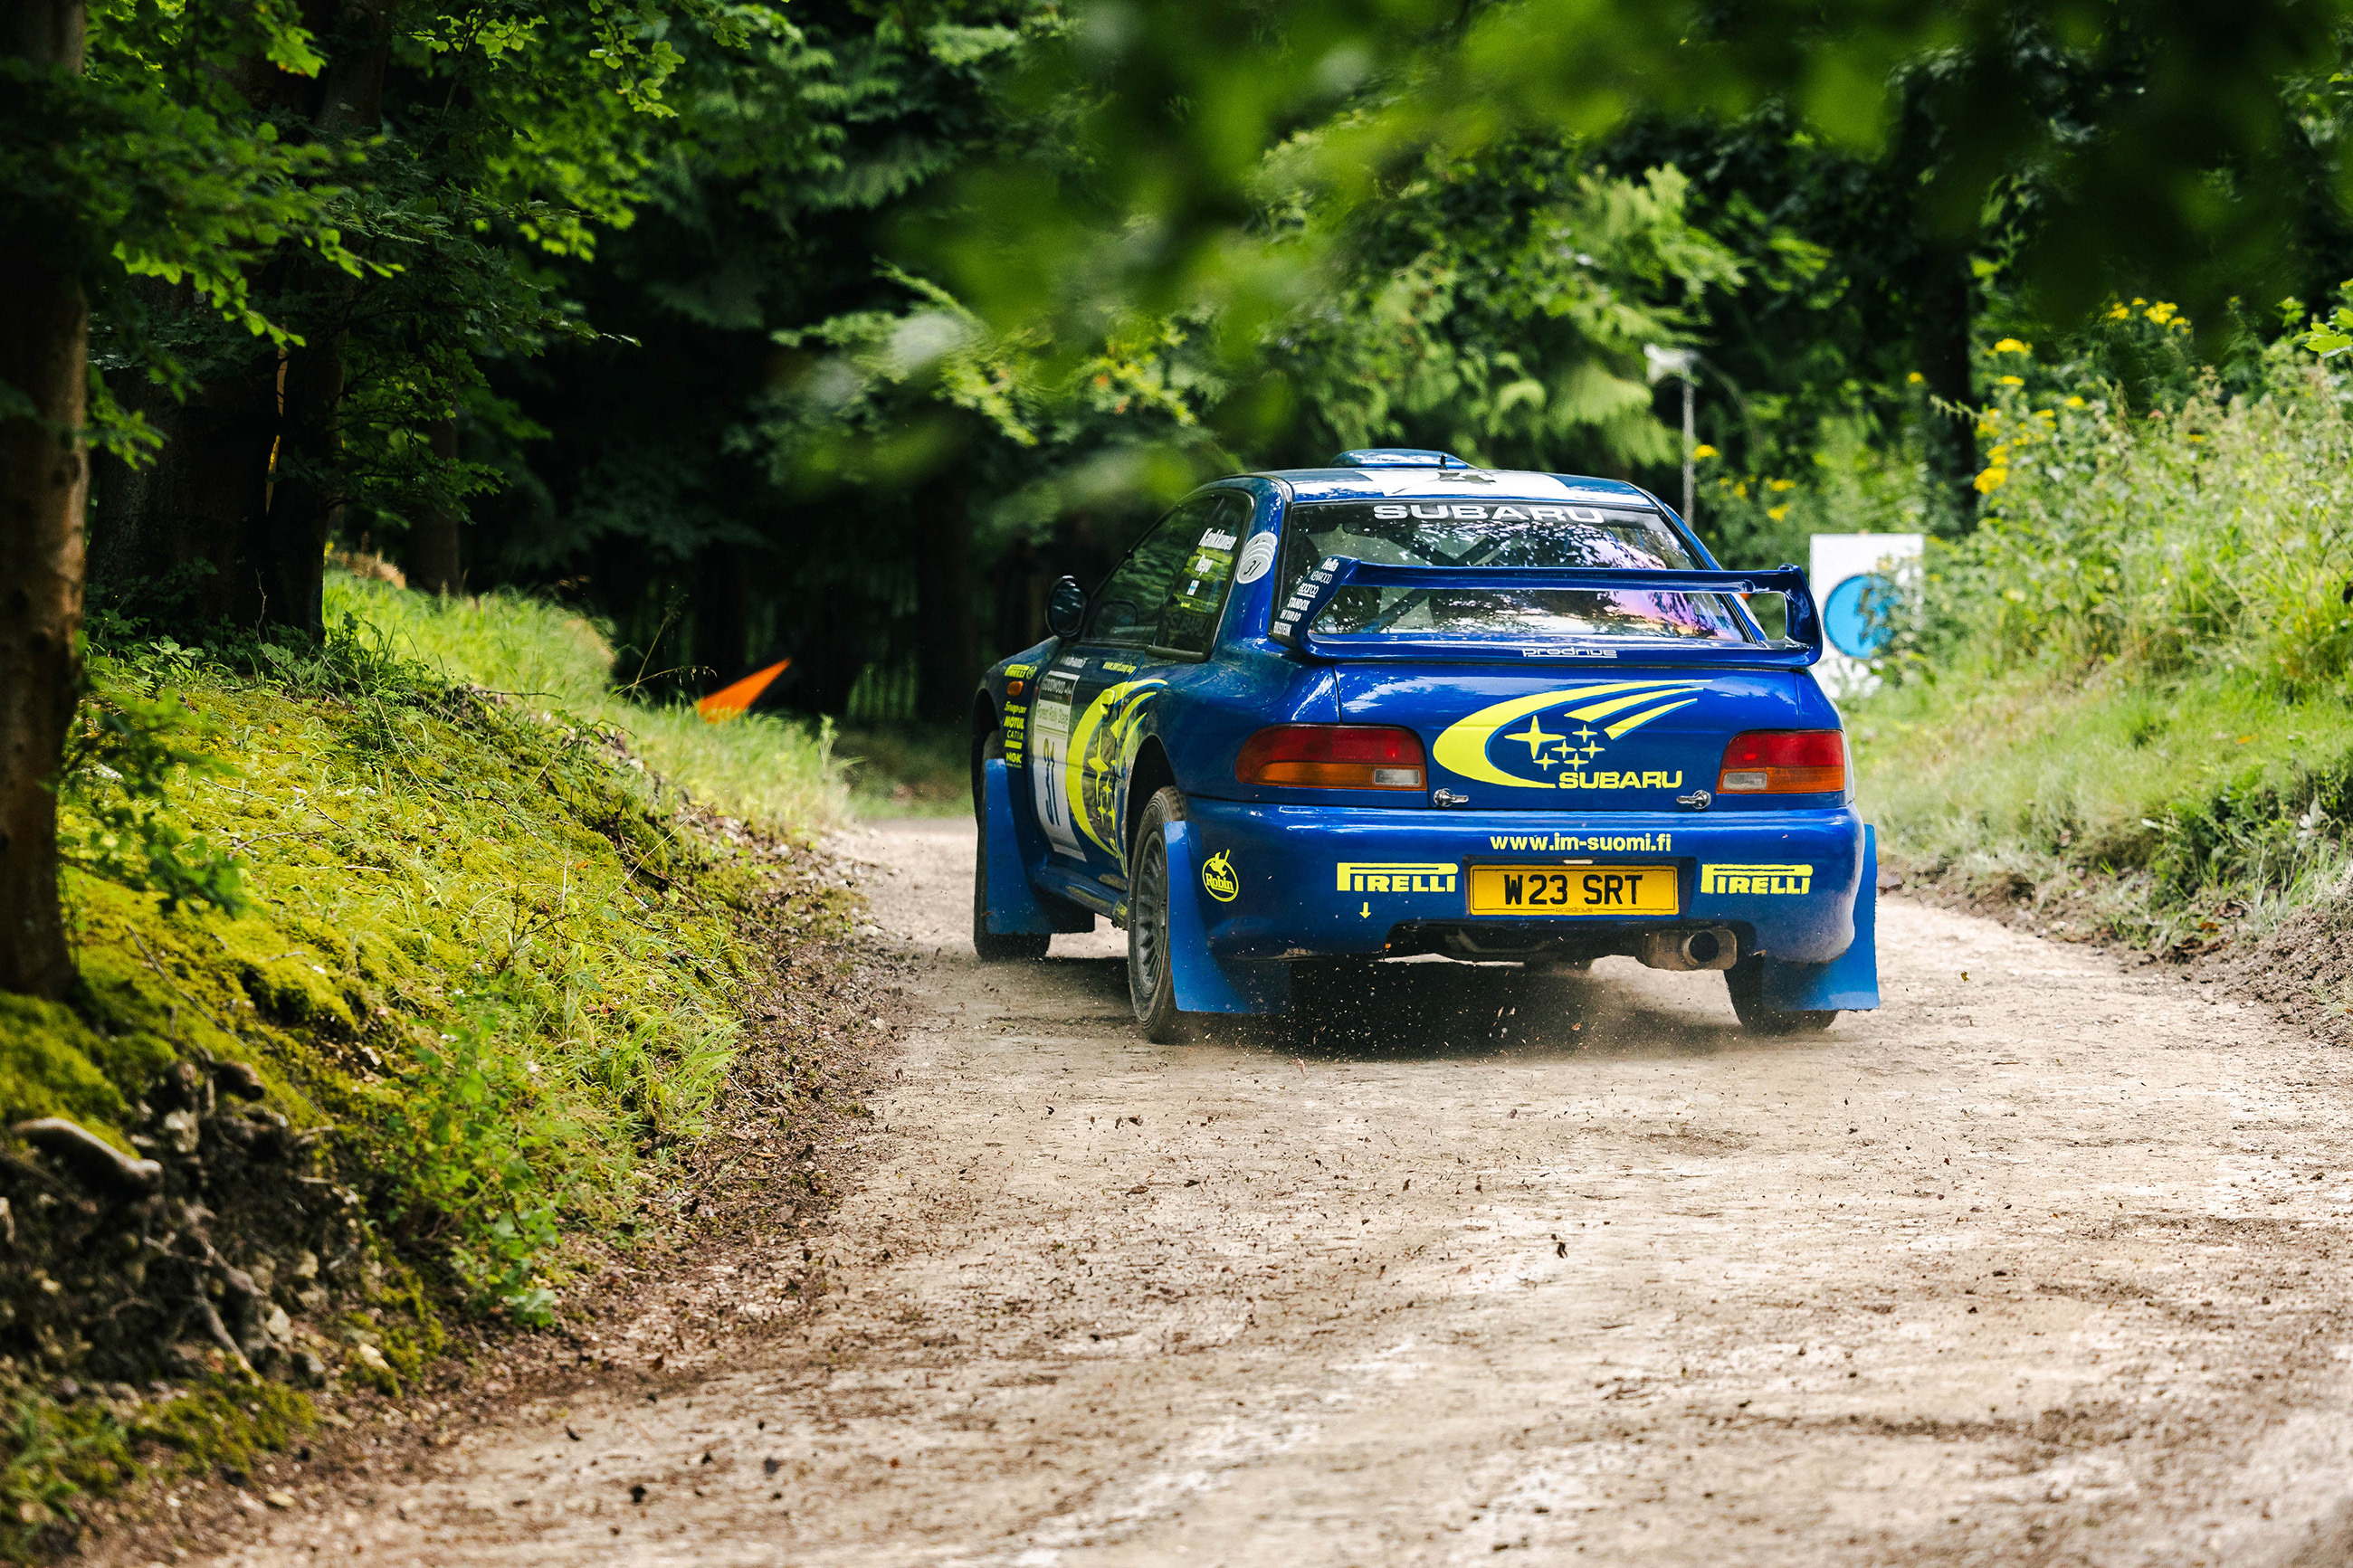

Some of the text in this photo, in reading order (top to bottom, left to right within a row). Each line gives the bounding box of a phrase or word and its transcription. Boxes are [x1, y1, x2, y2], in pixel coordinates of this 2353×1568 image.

[1373, 503, 1604, 523] SUBARU
[1243, 559, 1262, 577] 31
[1321, 557, 1339, 572] Hella
[1287, 596, 1310, 611] STANDOX
[1522, 645, 1617, 659] prodrive
[1004, 716, 1024, 729] MOTUL
[1043, 737, 1061, 827] 31
[1558, 770, 1683, 790] SUBARU
[1490, 832, 1672, 851] www.im-suomi.fi
[1205, 872, 1234, 894] Robin
[1336, 862, 1459, 892] PIRELLI
[1700, 863, 1814, 894] PIRELLI
[1503, 874, 1643, 905] W23 SRT
